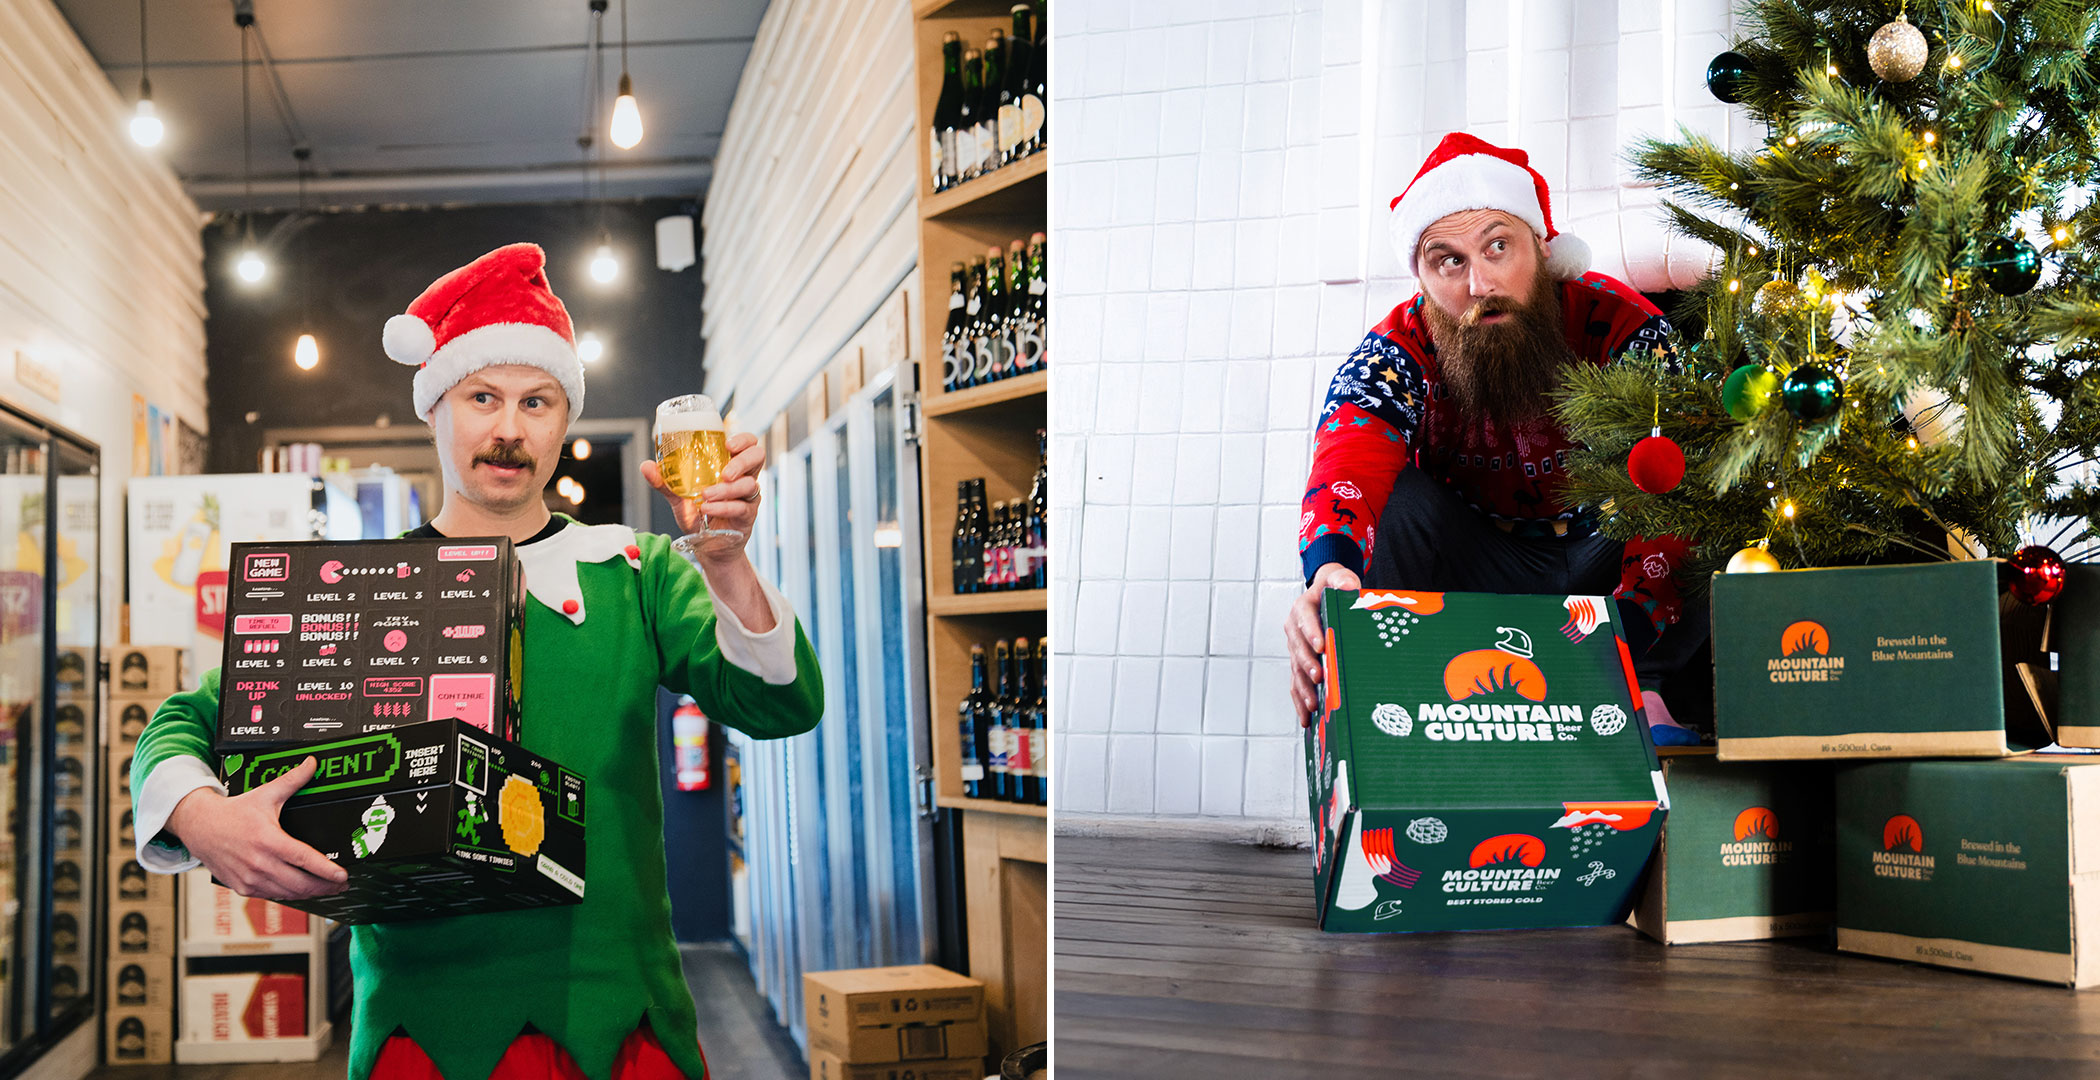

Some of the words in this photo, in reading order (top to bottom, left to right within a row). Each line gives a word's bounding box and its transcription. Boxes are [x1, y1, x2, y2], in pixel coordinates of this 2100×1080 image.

[253, 558, 280, 568] NEW
[249, 567, 283, 578] GAME
[306, 593, 342, 602] LEVEL
[347, 592, 356, 601] 2
[373, 591, 409, 600] LEVEL
[414, 591, 423, 600] 3
[440, 590, 476, 599] LEVEL
[482, 589, 490, 598] 4
[301, 613, 360, 623] BONUS!!
[300, 622, 359, 632] BONUS!!
[300, 632, 359, 641] BONUS!!
[1876, 635, 1916, 647] Brewed
[1917, 634, 1928, 646] in
[1929, 634, 1947, 646] the
[438, 655, 474, 665] LEVEL
[479, 655, 488, 664] 8
[1871, 651, 1895, 662] Blue
[1897, 649, 1954, 661] Mountains
[235, 660, 271, 668] LEVEL
[276, 659, 285, 668] 5
[302, 658, 338, 667] LEVEL
[343, 658, 352, 666] 6
[370, 657, 405, 666] LEVEL
[411, 656, 420, 665] 7
[1768, 657, 1845, 671] MOUNTAIN
[1769, 669, 1829, 683] CULTURE
[236, 681, 280, 691] DRINK
[297, 682, 332, 691] LEVEL
[339, 682, 354, 690] 10
[248, 691, 267, 701] UP
[295, 693, 353, 701] UNLOCKED!
[1418, 703, 1584, 722] MOUNTAIN
[230, 726, 266, 735] LEVEL
[271, 726, 280, 734] 9
[1424, 722, 1554, 742] CULTURE
[1556, 723, 1583, 732] Beer
[1557, 732, 1578, 741] Co.
[405, 744, 445, 760] INSERT
[1821, 744, 1830, 752] 16
[1838, 743, 1869, 752] 500mL
[1870, 743, 1892, 752] Cans
[410, 755, 438, 768] COIN
[409, 765, 438, 779] HERE
[1720, 842, 1793, 855] MOUNTAIN
[1961, 838, 1994, 851] Brewed
[1995, 841, 2005, 853] in
[2005, 842, 2021, 854] the
[1722, 853, 1778, 867] CULTURE
[1872, 851, 1935, 868] MOUNTAIN
[1957, 853, 1977, 865] Blue
[1977, 855, 2027, 870] Mountains
[1441, 868, 1561, 881] MOUNTAIN
[1874, 864, 1922, 880] CULTURE
[1442, 880, 1533, 893] CULTURE
[1473, 897, 1513, 905] STORED
